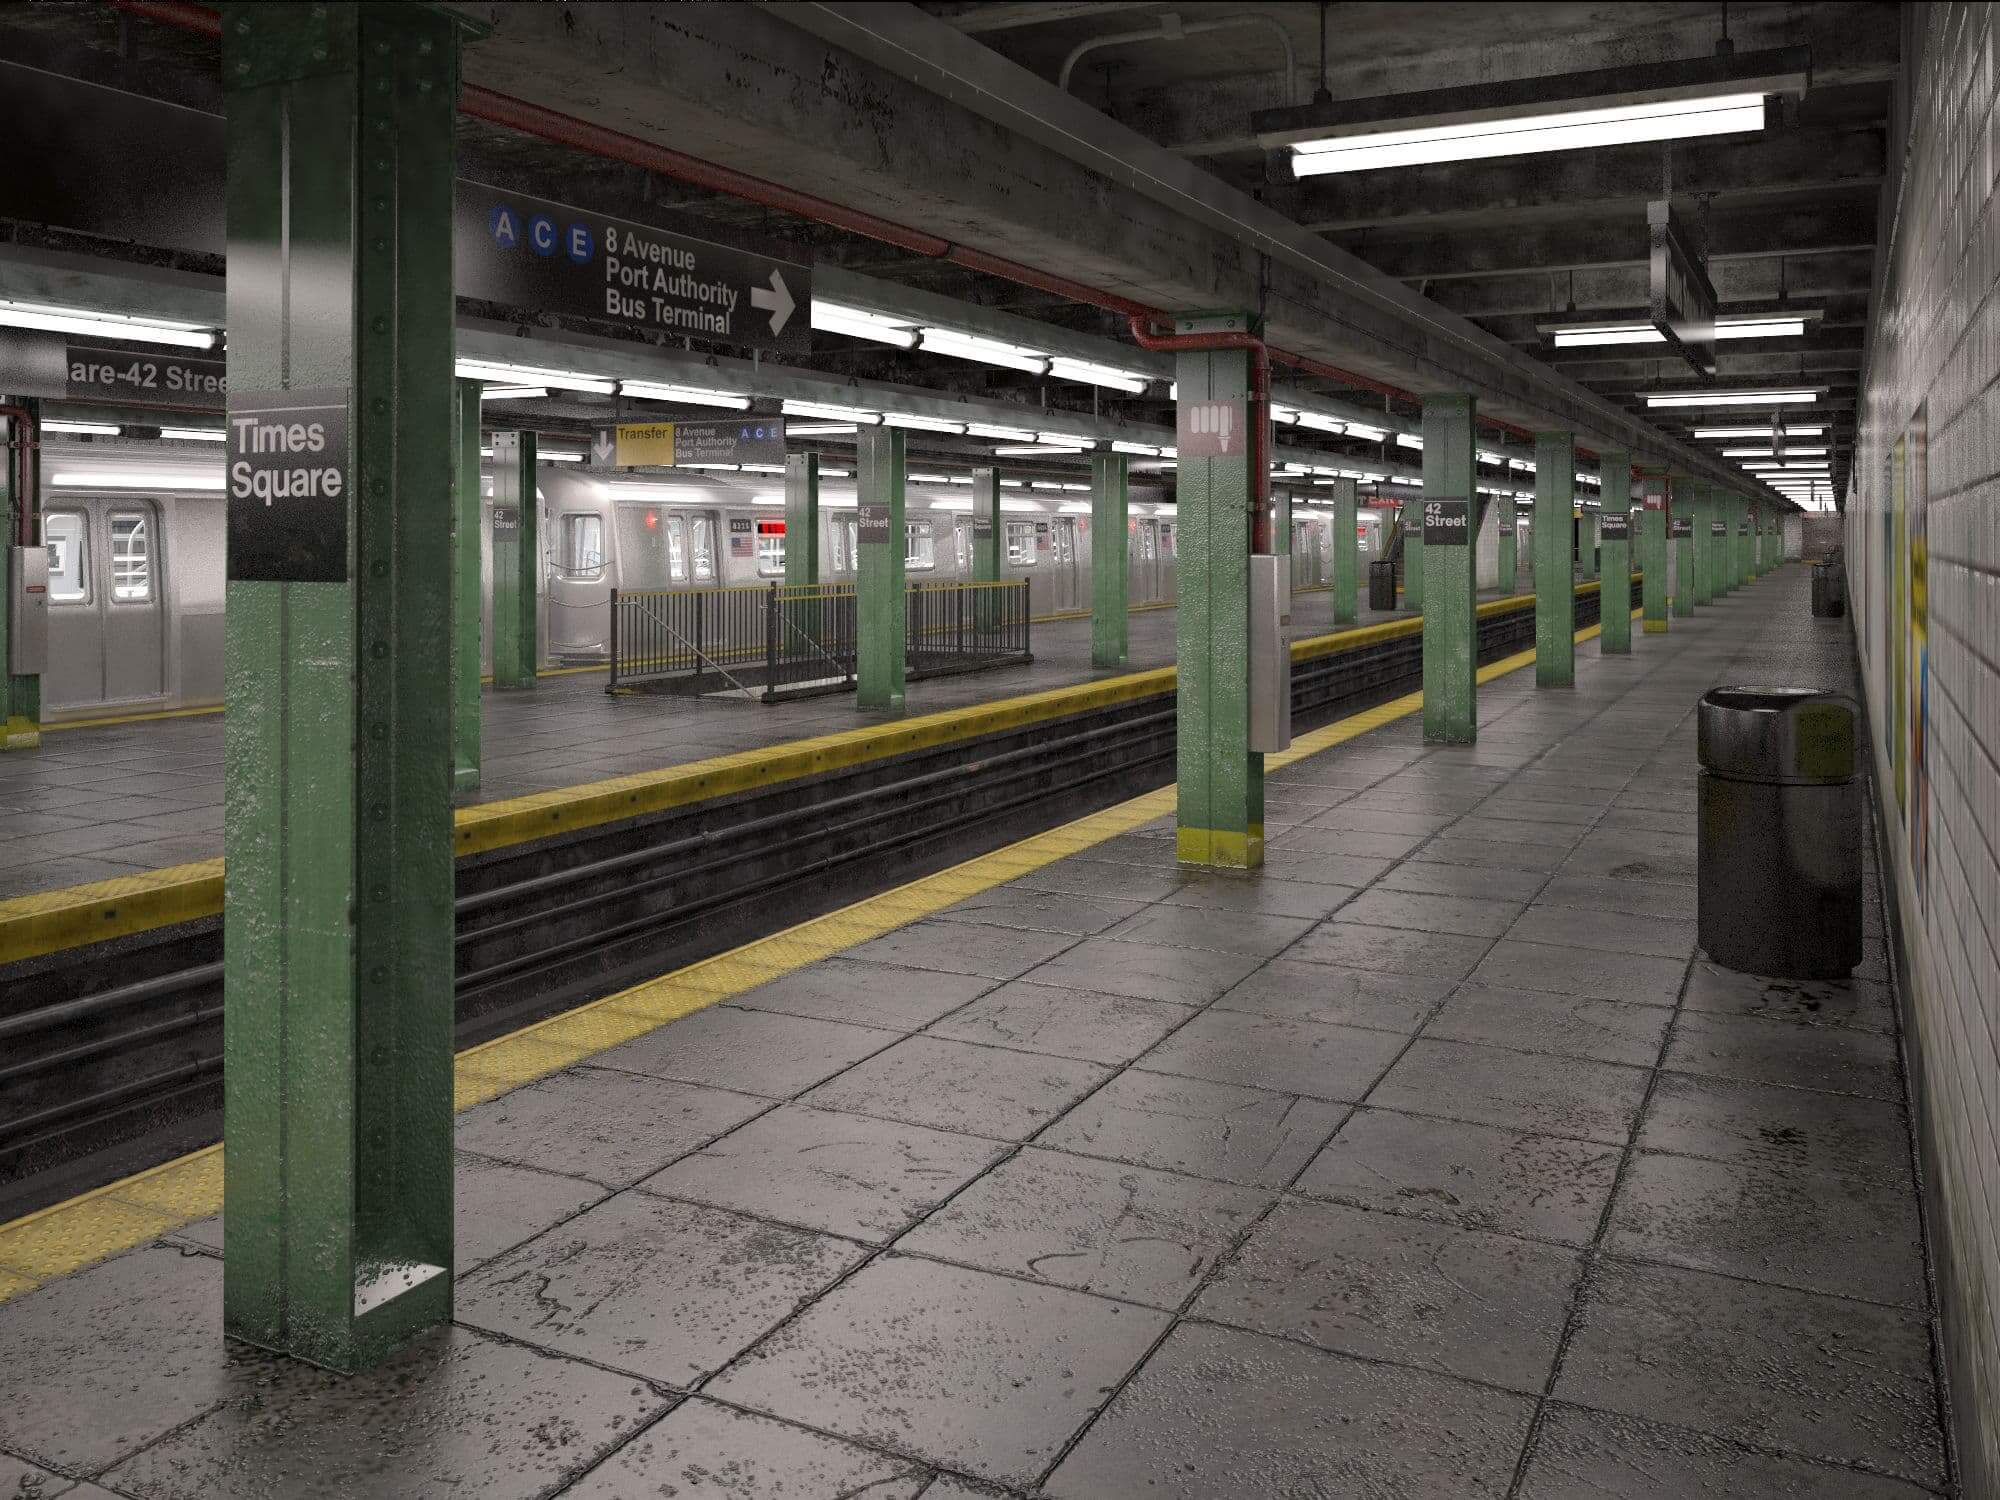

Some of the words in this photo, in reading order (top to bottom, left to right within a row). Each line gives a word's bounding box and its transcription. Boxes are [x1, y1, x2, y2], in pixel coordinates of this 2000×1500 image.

[494, 211, 515, 242] A
[534, 220, 552, 249] C
[572, 228, 587, 257] E
[605, 227, 618, 253] 8
[623, 232, 697, 271] Avenue
[606, 256, 649, 290] Port
[653, 268, 738, 313] Authority
[606, 288, 647, 321] Bus
[651, 297, 731, 335] Terminal
[232, 417, 325, 454] Times
[618, 427, 668, 440] Transfer
[683, 427, 716, 437] Avenue
[741, 428, 749, 439] A
[756, 428, 764, 438] C
[675, 437, 694, 447] Port
[696, 436, 737, 448] Authority
[675, 448, 693, 458] Bus
[695, 448, 734, 457] Terminal
[231, 461, 342, 507] Square
[859, 507, 871, 517] 42
[1425, 502, 1442, 514] 42
[494, 510, 504, 520] 42
[1425, 514, 1467, 527] Street
[494, 520, 517, 529] Street
[859, 517, 888, 528] Street
[1601, 521, 1627, 529] Square
